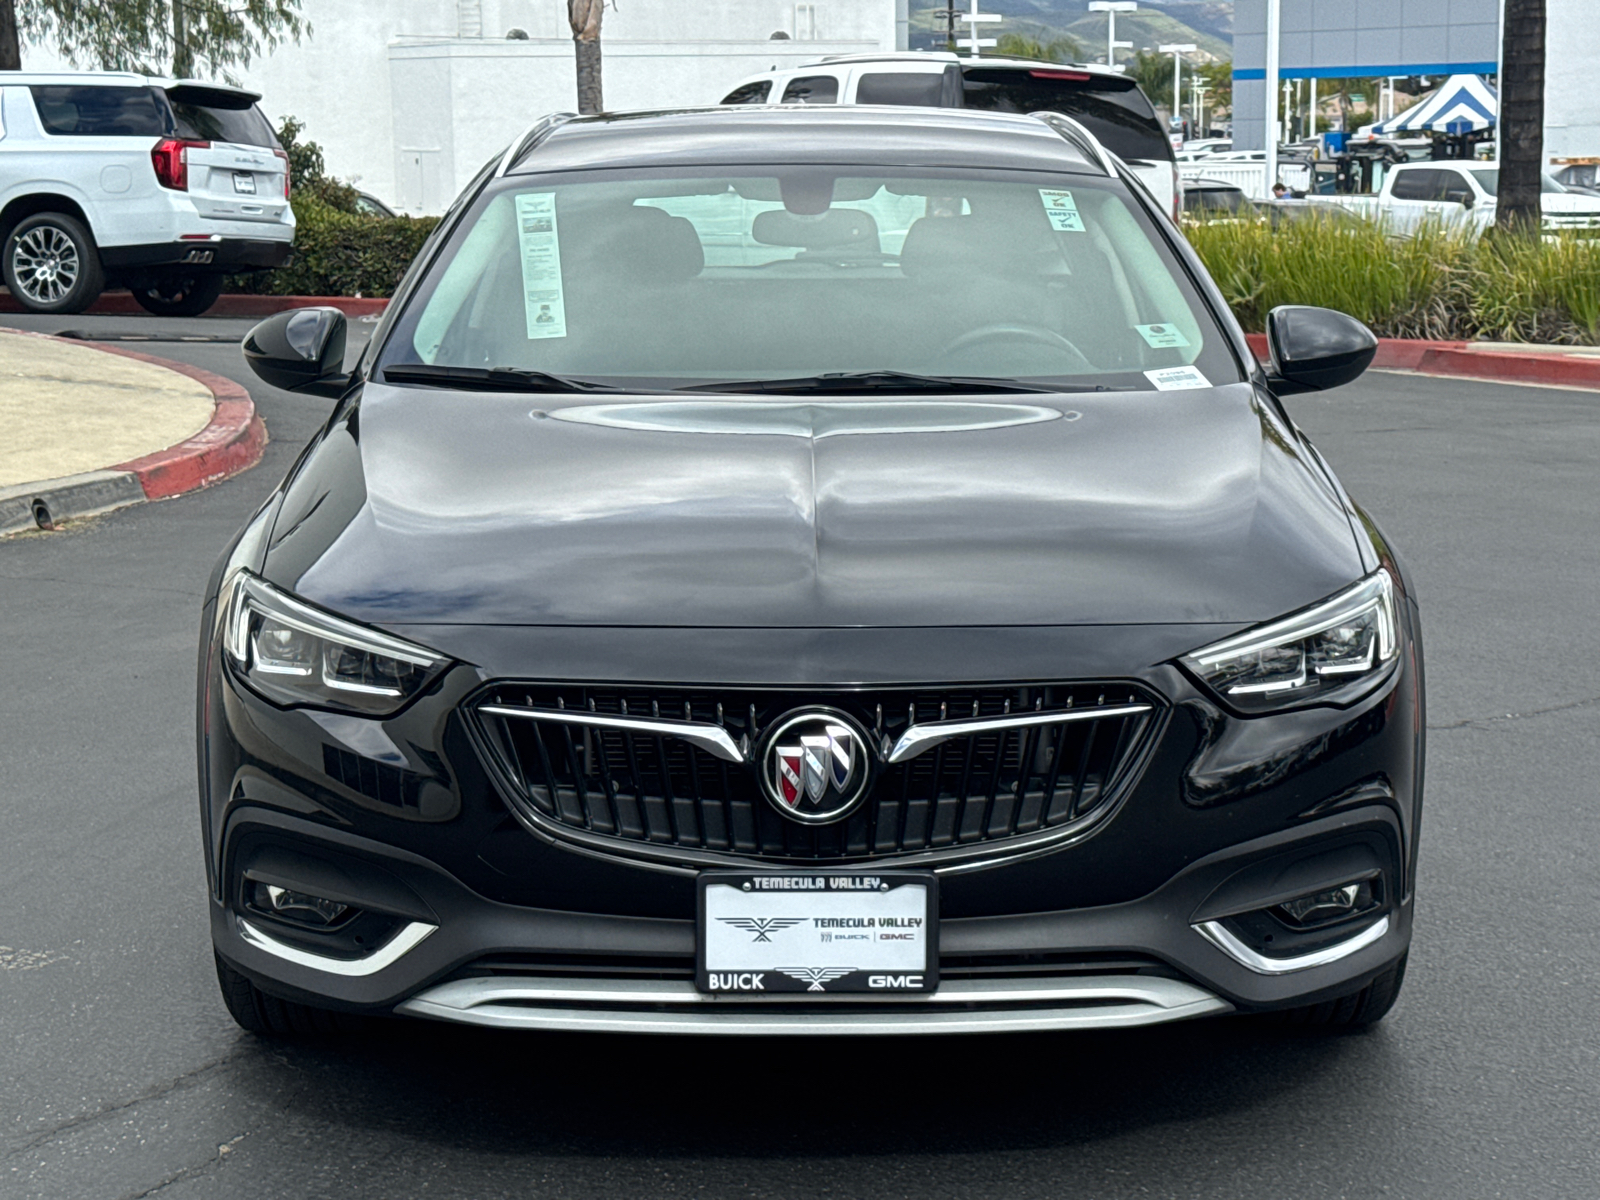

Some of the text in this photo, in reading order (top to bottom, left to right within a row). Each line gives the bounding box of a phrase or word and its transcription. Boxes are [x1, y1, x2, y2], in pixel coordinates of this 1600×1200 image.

[753, 877, 881, 889] TEMECULA VALLEY
[813, 917, 922, 928] TEMECULA VALLEY
[709, 973, 924, 990] BUICK GMC
